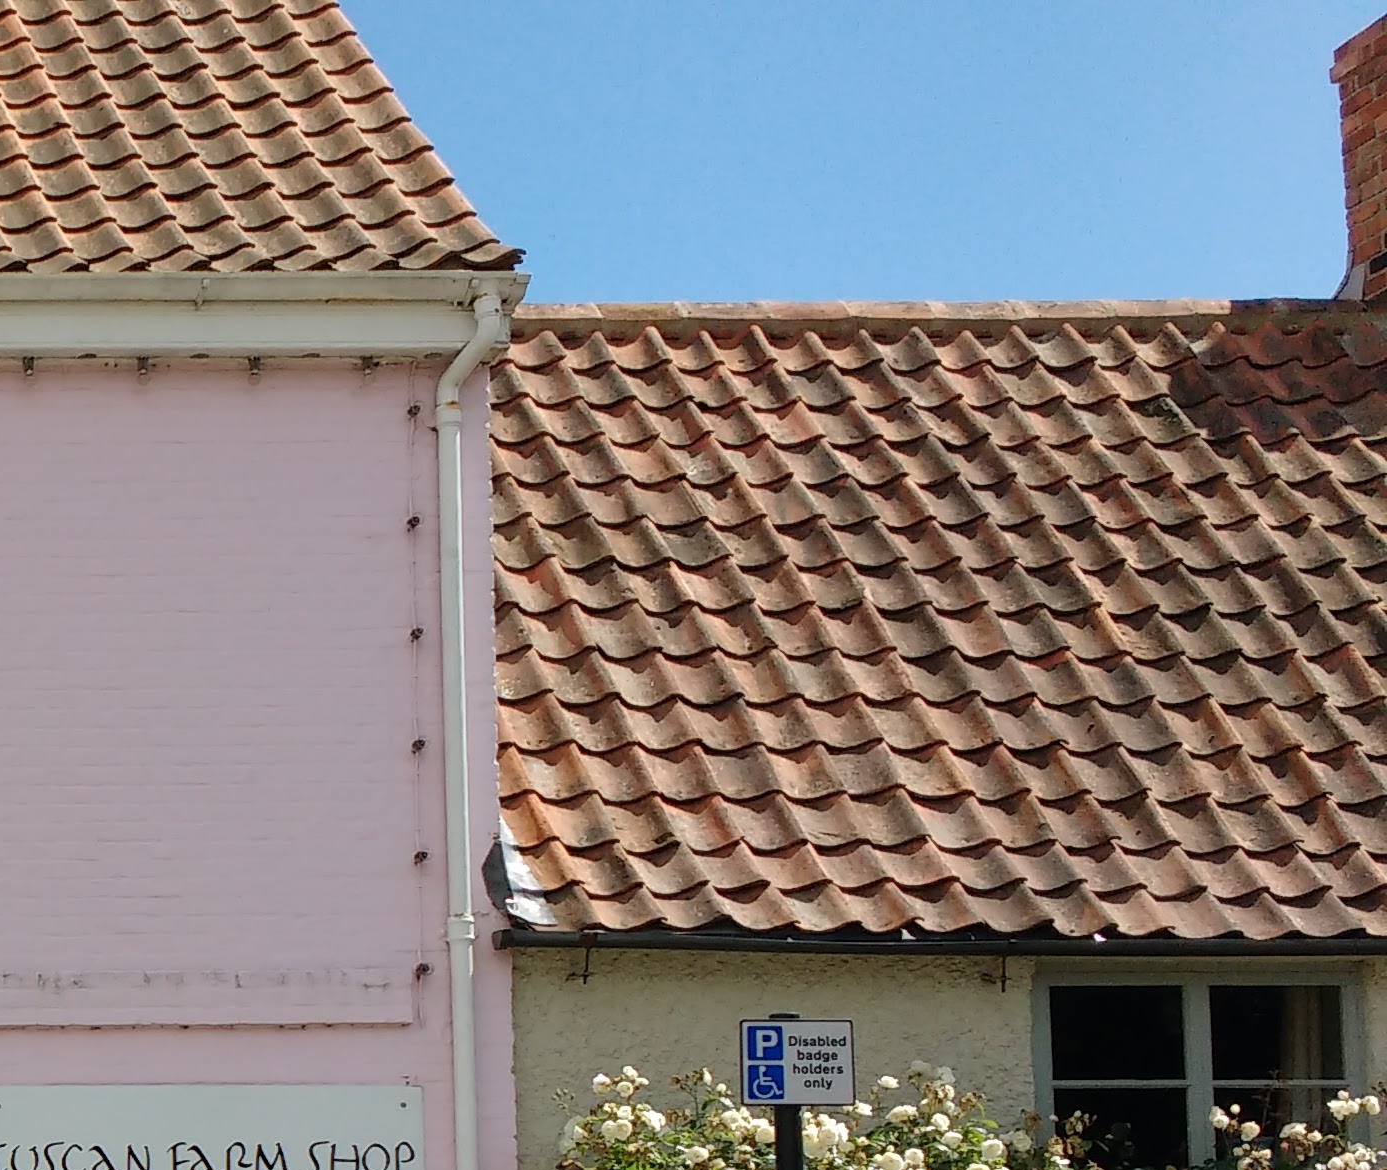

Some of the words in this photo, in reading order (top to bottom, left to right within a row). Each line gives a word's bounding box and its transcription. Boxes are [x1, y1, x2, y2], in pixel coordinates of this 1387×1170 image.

[755, 1030, 779, 1058] P
[788, 1036, 847, 1047] Disabled
[797, 1050, 838, 1062] badge
[792, 1064, 844, 1074] holders
[804, 1077, 833, 1090] only
